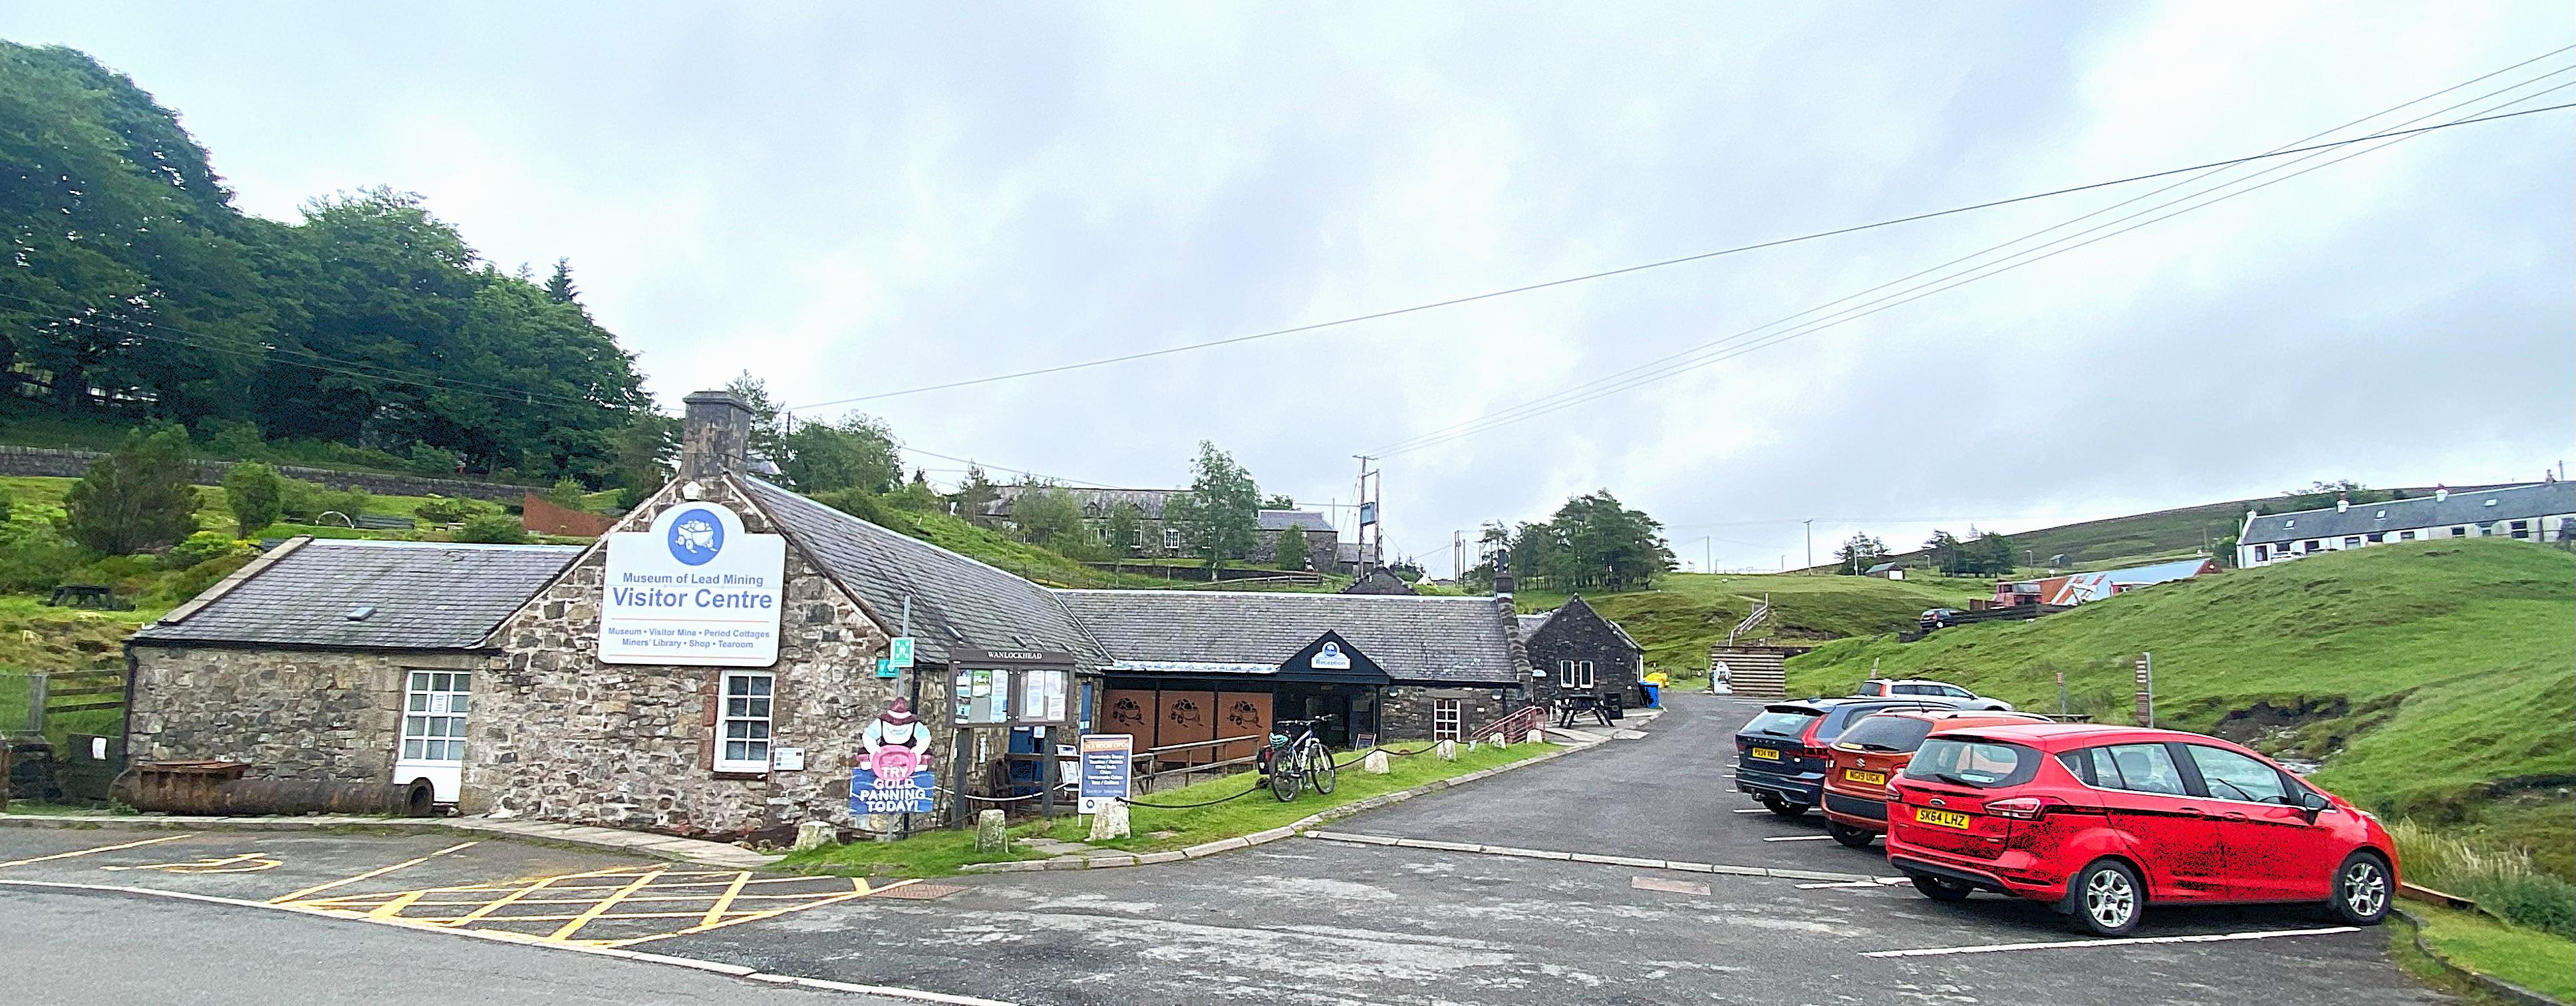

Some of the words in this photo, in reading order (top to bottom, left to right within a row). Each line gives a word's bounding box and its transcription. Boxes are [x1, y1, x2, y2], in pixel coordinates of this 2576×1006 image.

[623, 573, 672, 584] Museum
[676, 574, 688, 584] of
[691, 574, 720, 584] Lead
[724, 575, 764, 587] Mining
[613, 587, 687, 607] Visitor
[695, 589, 772, 609] Centre
[653, 639, 681, 649] Library
[689, 640, 710, 649] Shop
[881, 766, 908, 778] TRY
[1866, 773, 1880, 782] UGK
[873, 778, 915, 789] GOLD
[859, 789, 926, 802] PANNING
[866, 800, 919, 812] TODAY!
[1920, 810, 1942, 822] SK64
[1944, 813, 1965, 826] LHZ
